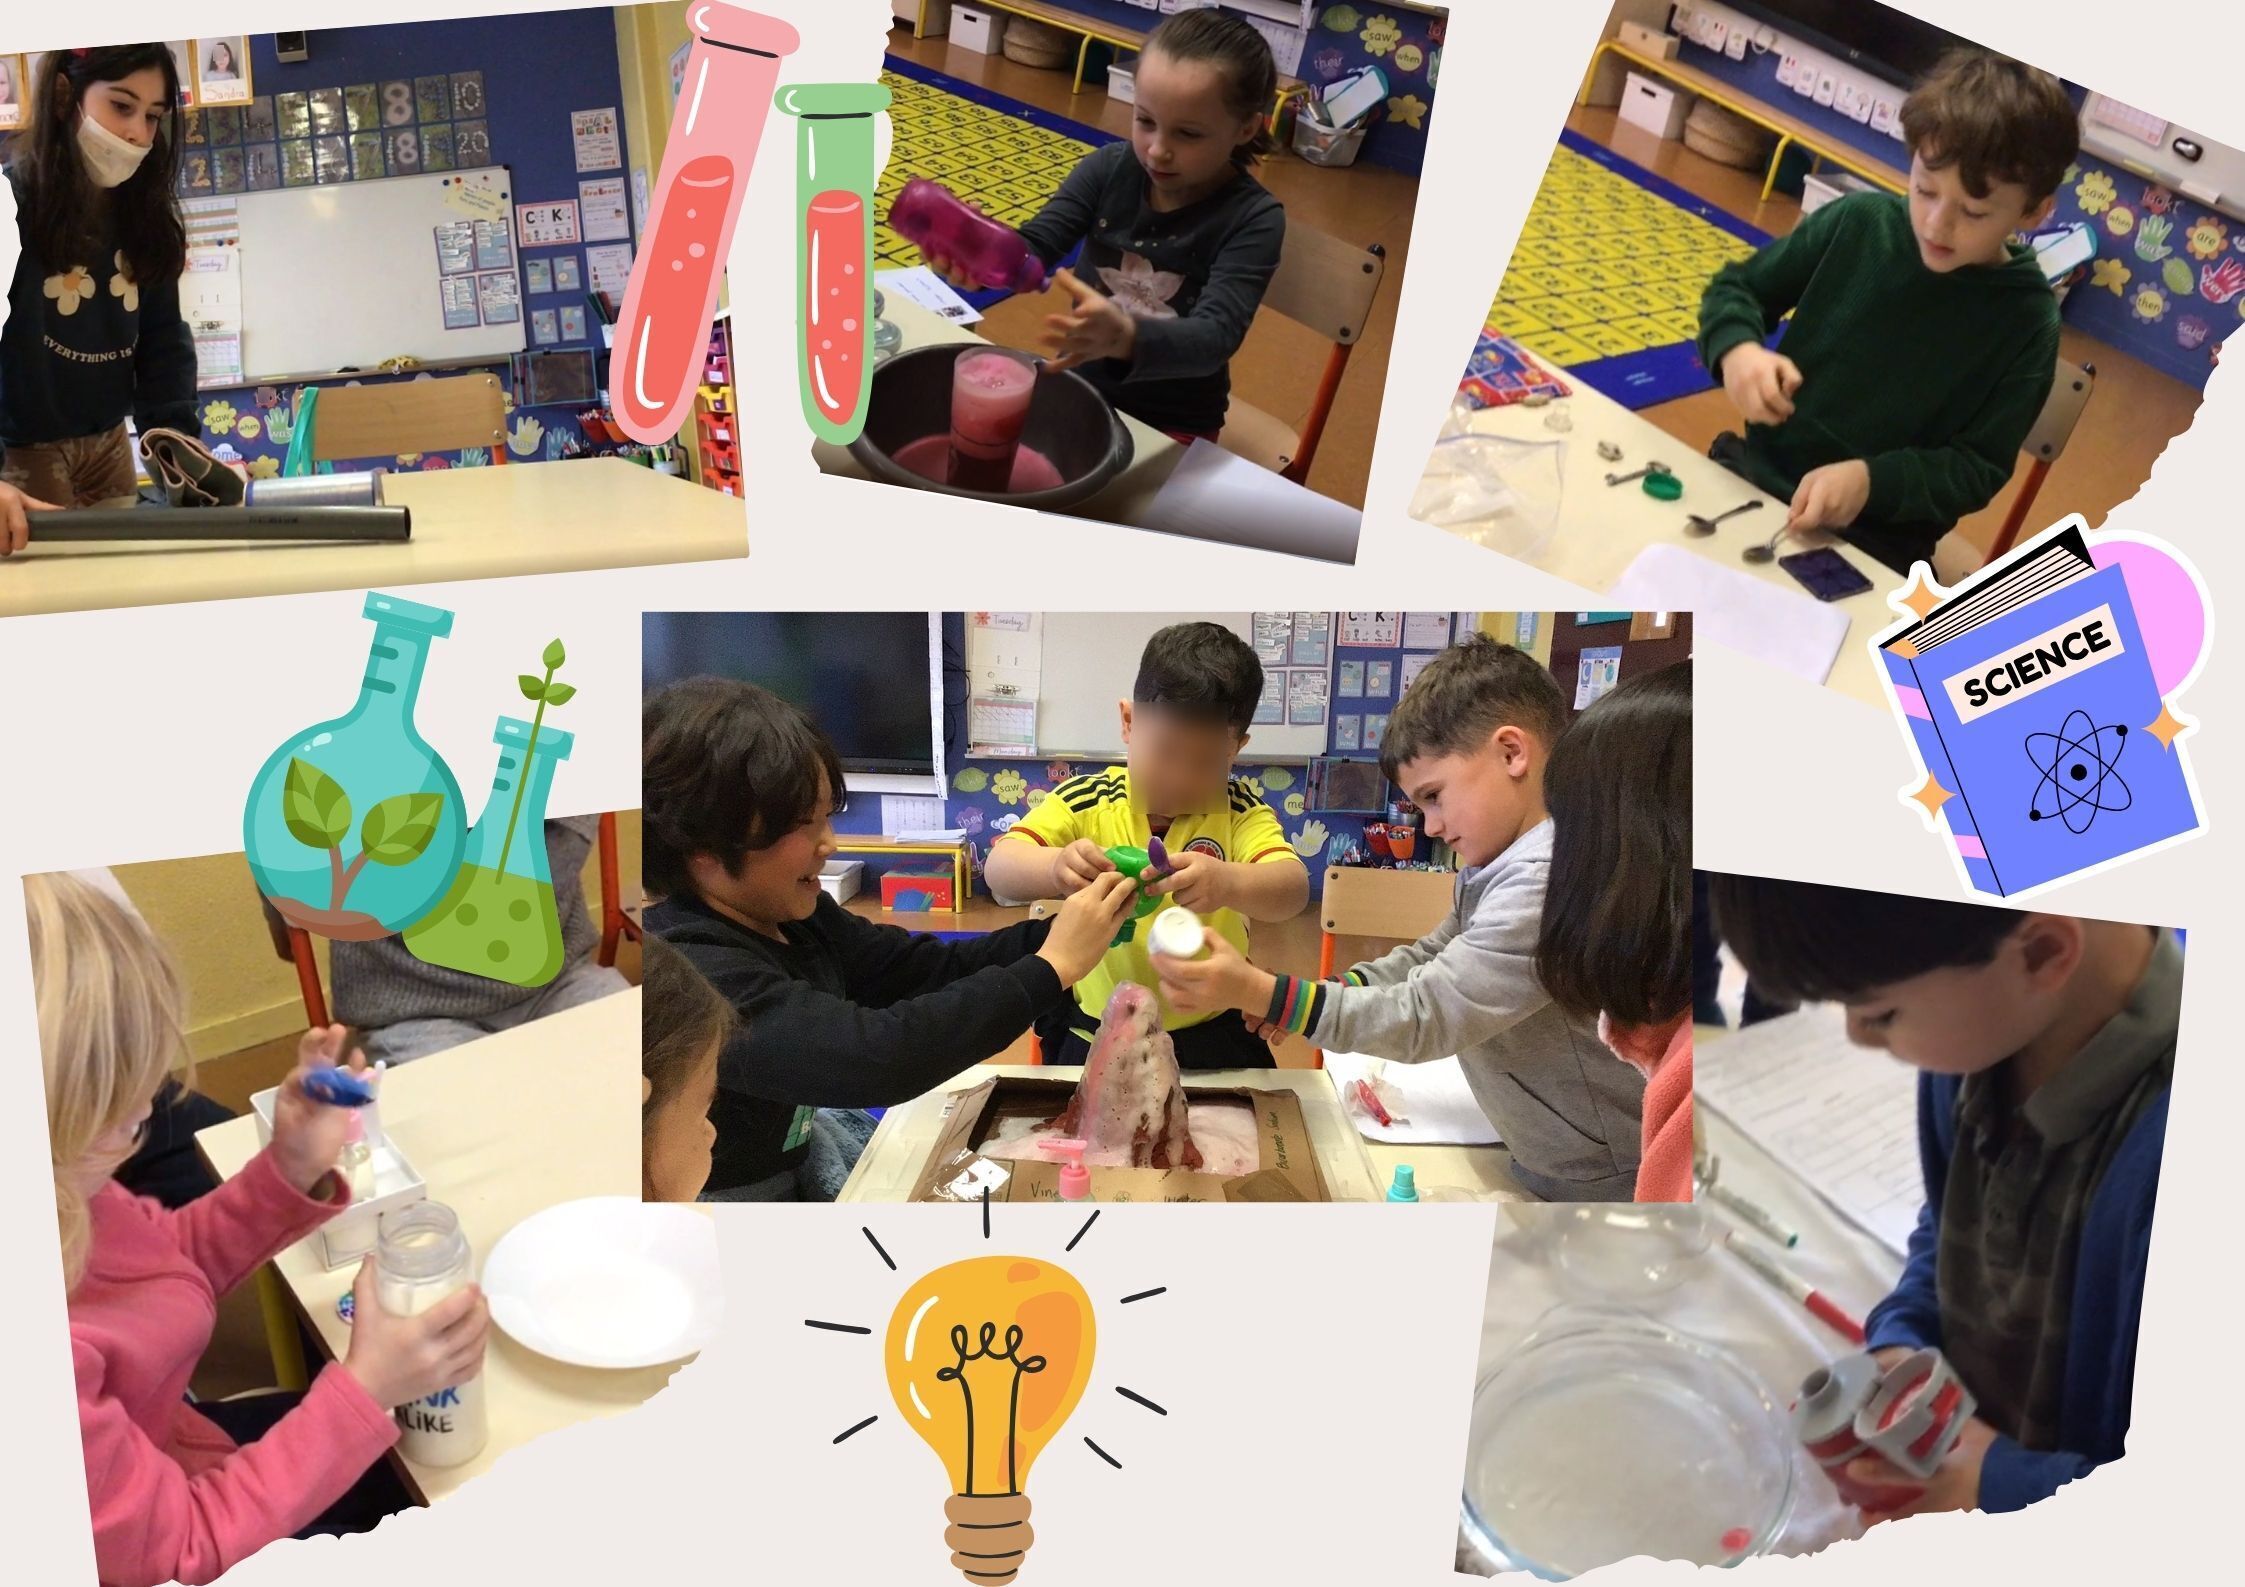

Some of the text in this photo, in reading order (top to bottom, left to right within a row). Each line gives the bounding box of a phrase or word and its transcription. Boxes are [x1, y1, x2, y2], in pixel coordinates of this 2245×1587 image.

[1369, 31, 1392, 42] saw
[1314, 56, 1342, 70] their
[1397, 53, 1419, 64] when
[205, 84, 246, 101] Sandra
[384, 82, 412, 124] 8
[453, 81, 482, 111] 10
[913, 102, 937, 114] 87
[939, 96, 959, 109] 97
[945, 112, 966, 123] 86
[999, 118, 1020, 129] 95
[919, 119, 940, 129] 76
[974, 124, 998, 135] 85
[948, 131, 972, 142] 75
[1031, 129, 1051, 142] 94
[387, 132, 419, 164] 18
[456, 130, 490, 154] 20
[923, 138, 945, 150] 65
[1008, 137, 1031, 149] 84
[1061, 142, 1084, 154] 93
[981, 144, 1006, 156] 74
[1038, 149, 1064, 161] 83
[955, 152, 980, 164] 64
[1013, 156, 1040, 168] 73
[924, 159, 952, 171] 54
[986, 165, 1014, 176] 63
[958, 174, 986, 186] 53
[1023, 179, 1051, 191] 62
[995, 187, 1025, 200] 52
[2085, 188, 2107, 200] saw
[525, 208, 562, 224] C K
[2109, 215, 2131, 228] when
[2197, 233, 2216, 247] are
[195, 258, 223, 271] Tuesday
[2138, 298, 2160, 312] then
[2178, 322, 2207, 341] said
[1583, 330, 1624, 351] 21
[119, 347, 132, 358] IS
[1535, 339, 1572, 358] 11
[210, 413, 231, 425] saw
[239, 422, 259, 431] when
[212, 450, 240, 461] ome
[993, 615, 1023, 631] Tuesday
[999, 784, 1020, 793] saw
[1028, 796, 1045, 804] whe
[1287, 800, 1304, 809] me
[959, 811, 984, 829] their
